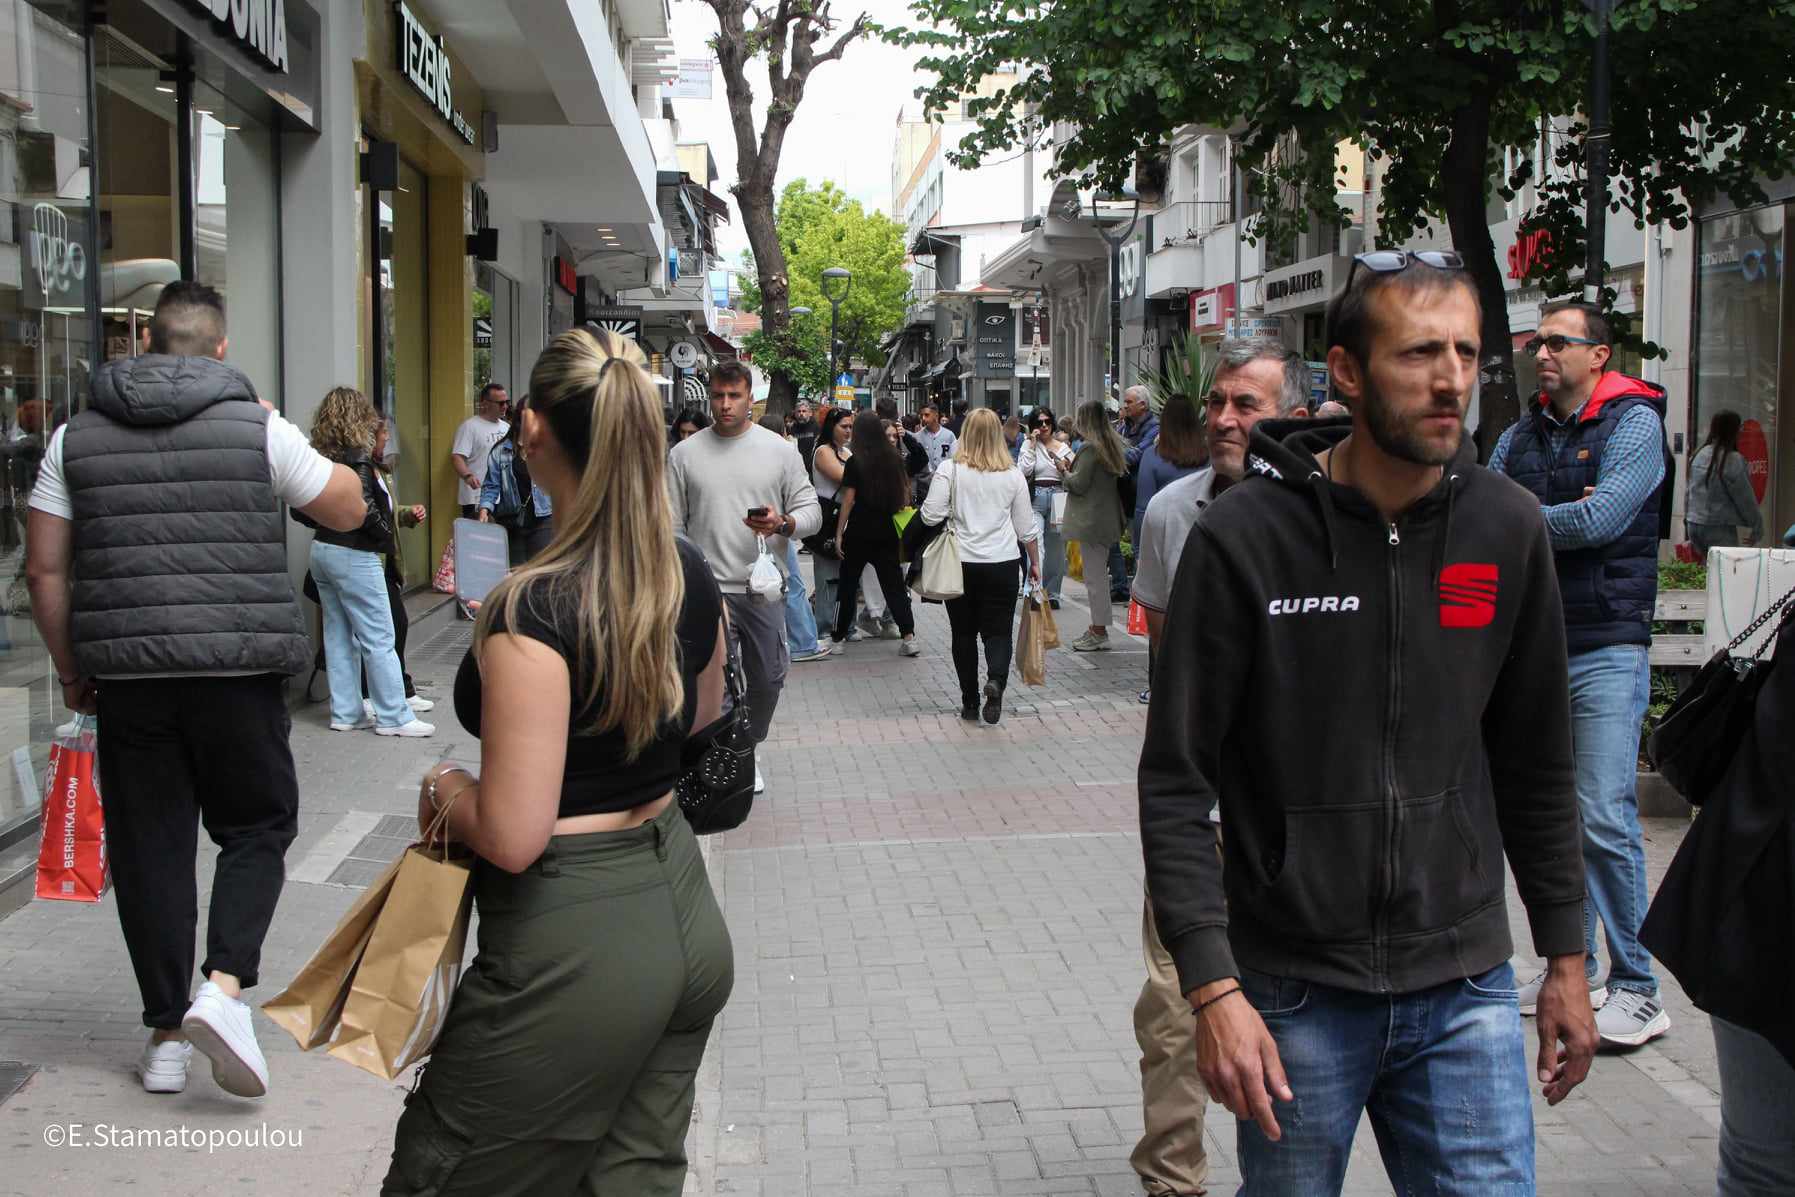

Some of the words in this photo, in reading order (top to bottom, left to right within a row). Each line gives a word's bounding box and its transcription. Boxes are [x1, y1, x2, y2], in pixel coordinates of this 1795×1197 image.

[400, 0, 452, 120] TEZENIS
[1268, 595, 1361, 616] CUPRA
[63, 777, 80, 869] BERSHKA.COM
